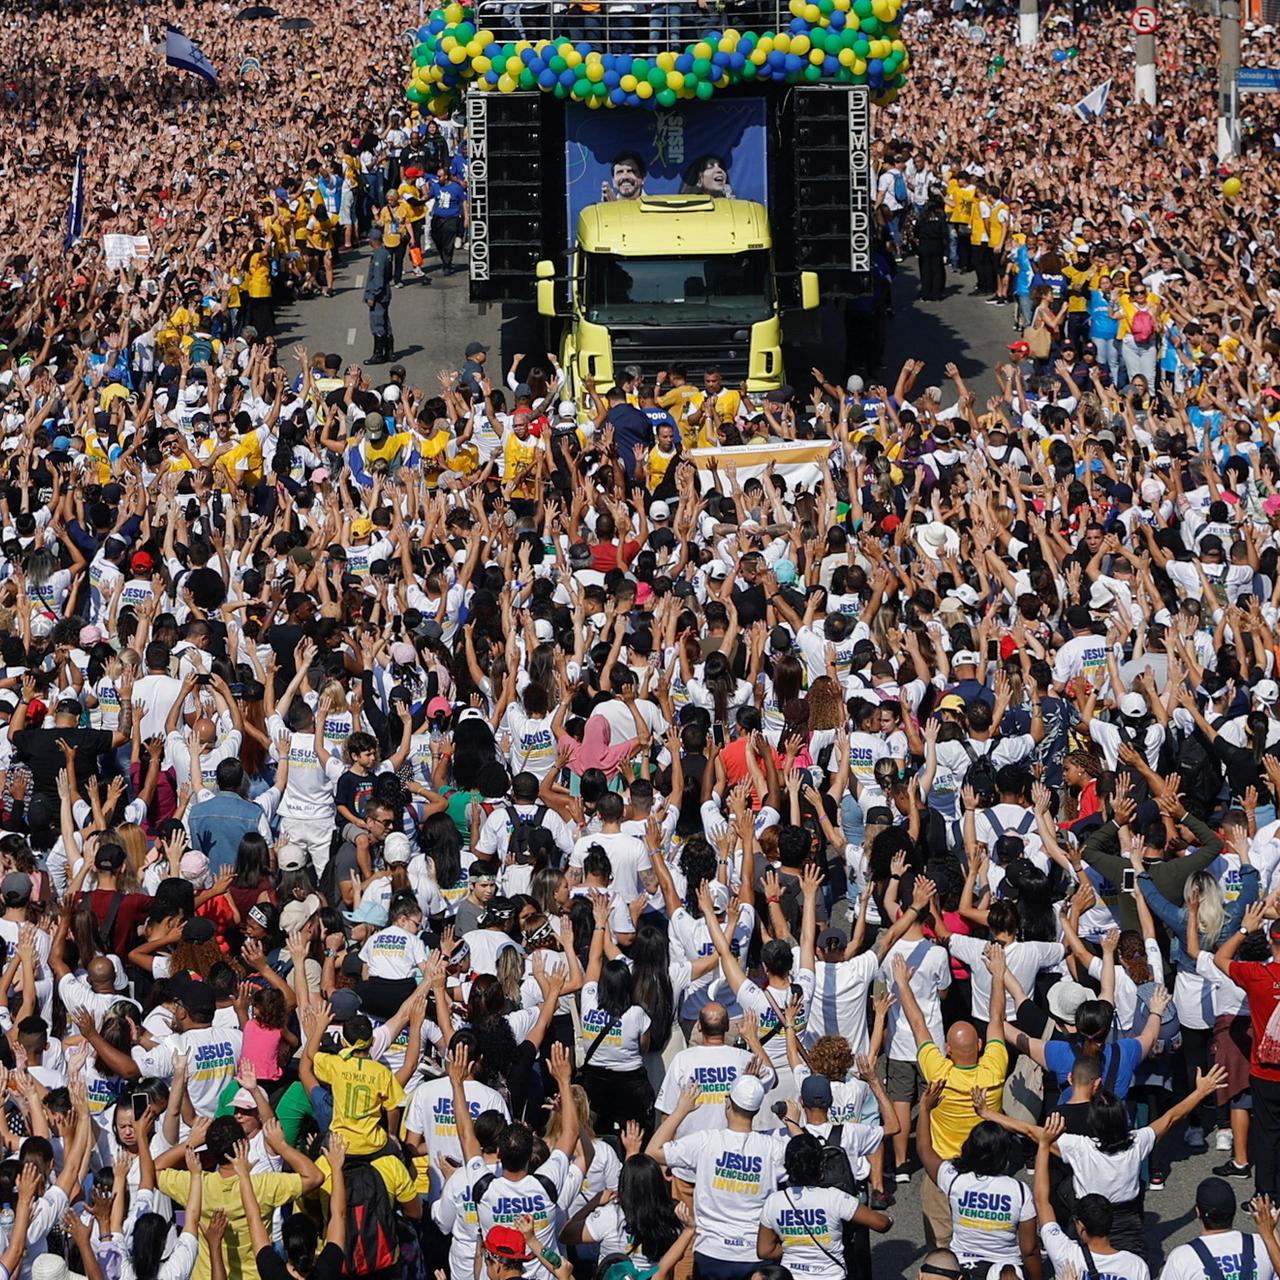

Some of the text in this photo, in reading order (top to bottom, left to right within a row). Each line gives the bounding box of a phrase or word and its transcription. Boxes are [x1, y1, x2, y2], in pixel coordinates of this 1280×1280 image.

[669, 115, 684, 164] JESUS
[373, 934, 407, 945] JESUS
[195, 1042, 234, 1060] JESUS
[196, 1057, 235, 1070] VENCEDOR
[691, 1066, 737, 1083] JESUS
[345, 1083, 371, 1119] 10
[716, 1151, 762, 1173] JESUS
[714, 1167, 761, 1182] VENCEDOR
[492, 1195, 545, 1213] JESUS
[958, 1190, 1012, 1211] JESUS
[776, 1209, 827, 1226] JESUS
[958, 1207, 1011, 1222] VENCEDOR
